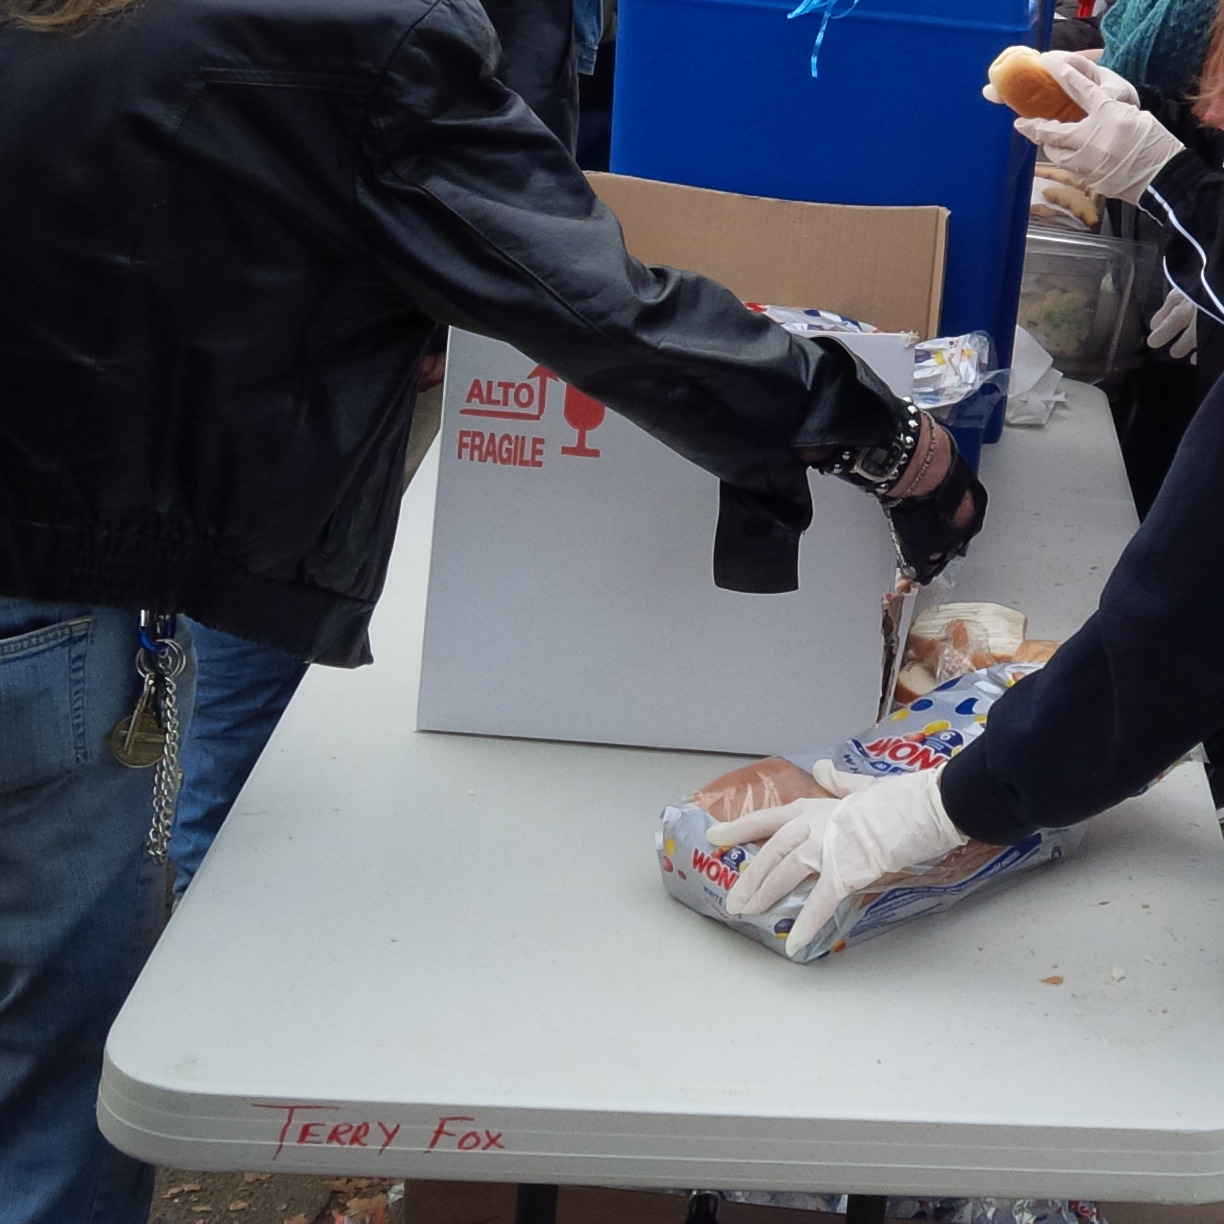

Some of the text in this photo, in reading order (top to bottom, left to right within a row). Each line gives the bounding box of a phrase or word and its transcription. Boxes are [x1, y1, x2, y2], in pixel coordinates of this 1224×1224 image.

[466, 378, 535, 409] ALTO
[457, 429, 546, 468] FRAGILE
[866, 737, 948, 771] WON
[692, 847, 740, 892] WON
